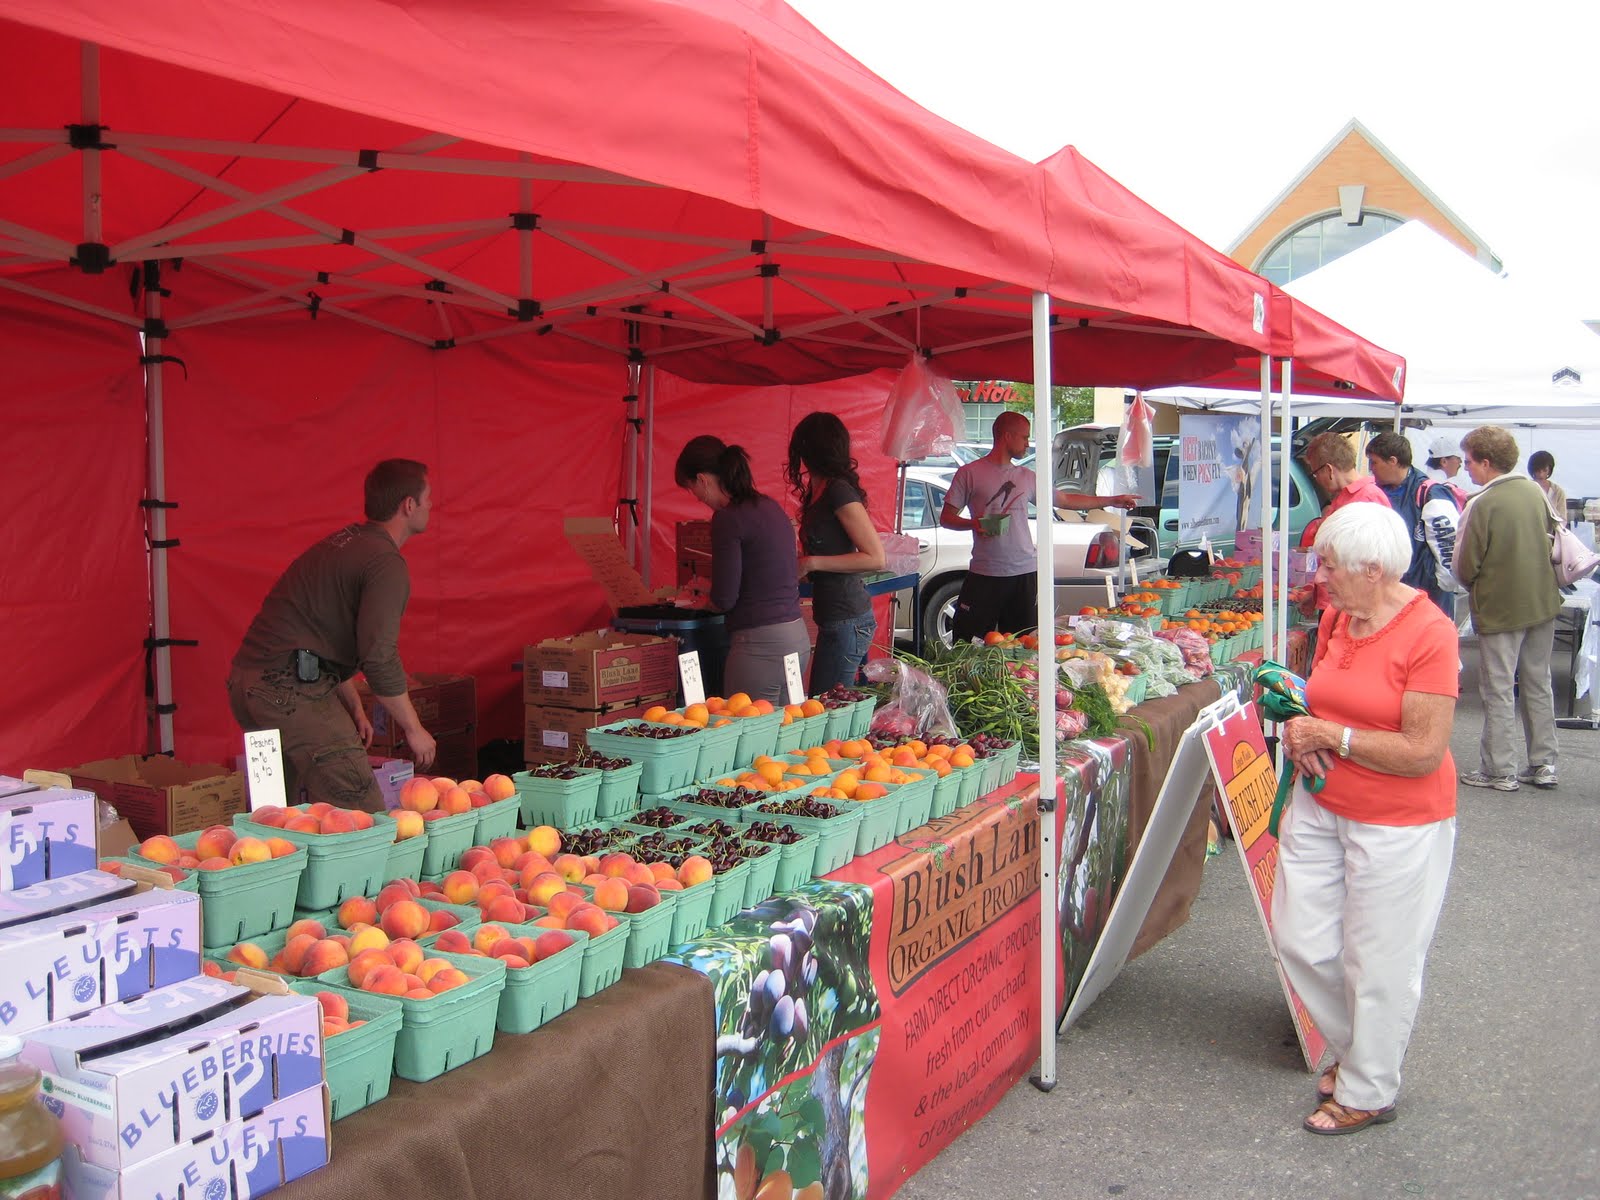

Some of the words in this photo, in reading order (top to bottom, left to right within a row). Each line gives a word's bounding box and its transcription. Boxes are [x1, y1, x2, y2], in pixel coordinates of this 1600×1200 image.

[1198, 463, 1212, 483] PIGS
[1212, 463, 1221, 479] FLY
[891, 902, 976, 983] ORGANIC
[981, 859, 1041, 925] PRODUC
[898, 836, 983, 936] Blush
[990, 819, 1037, 877] Lan
[0, 927, 183, 1026] BLEUETS
[904, 1004, 930, 1051] FARM
[928, 974, 961, 1025] DIRECT
[963, 941, 1005, 994] ORGANIC
[1005, 912, 1041, 960] PRODUC
[926, 1034, 952, 1078] fresh
[951, 1018, 975, 1051] from
[992, 960, 1026, 1011] orchard
[120, 1033, 316, 1149] BLUEBERRIES
[914, 1096, 928, 1117] &
[931, 1081, 952, 1109] the
[954, 1051, 979, 1092] local
[981, 1008, 1030, 1068] community
[918, 1123, 936, 1149] of
[936, 1090, 983, 1133] organic
